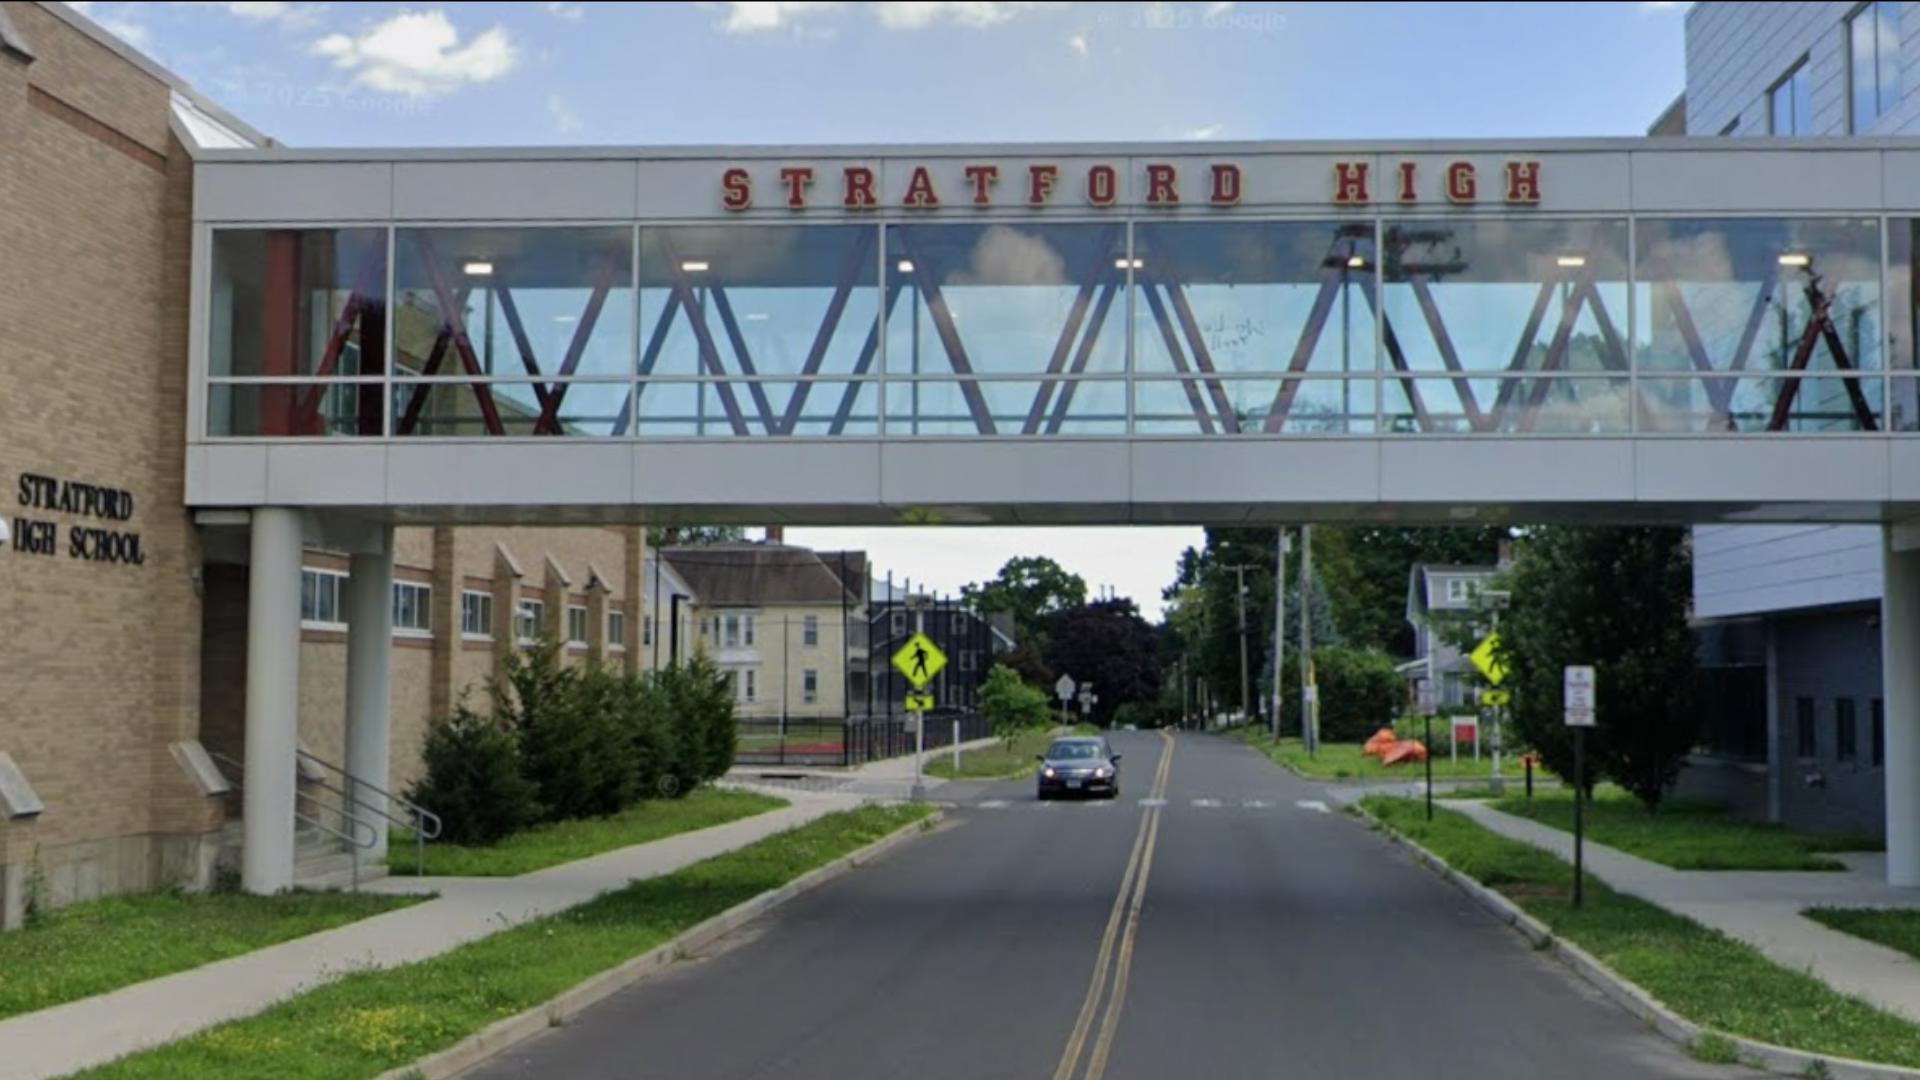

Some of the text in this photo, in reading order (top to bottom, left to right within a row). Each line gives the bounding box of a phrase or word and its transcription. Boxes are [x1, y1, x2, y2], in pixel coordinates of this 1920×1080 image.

[721, 159, 1544, 210] STRATFORD HIGH
[18, 472, 134, 522] STRATFORD
[69, 525, 146, 566] SCHOOL
